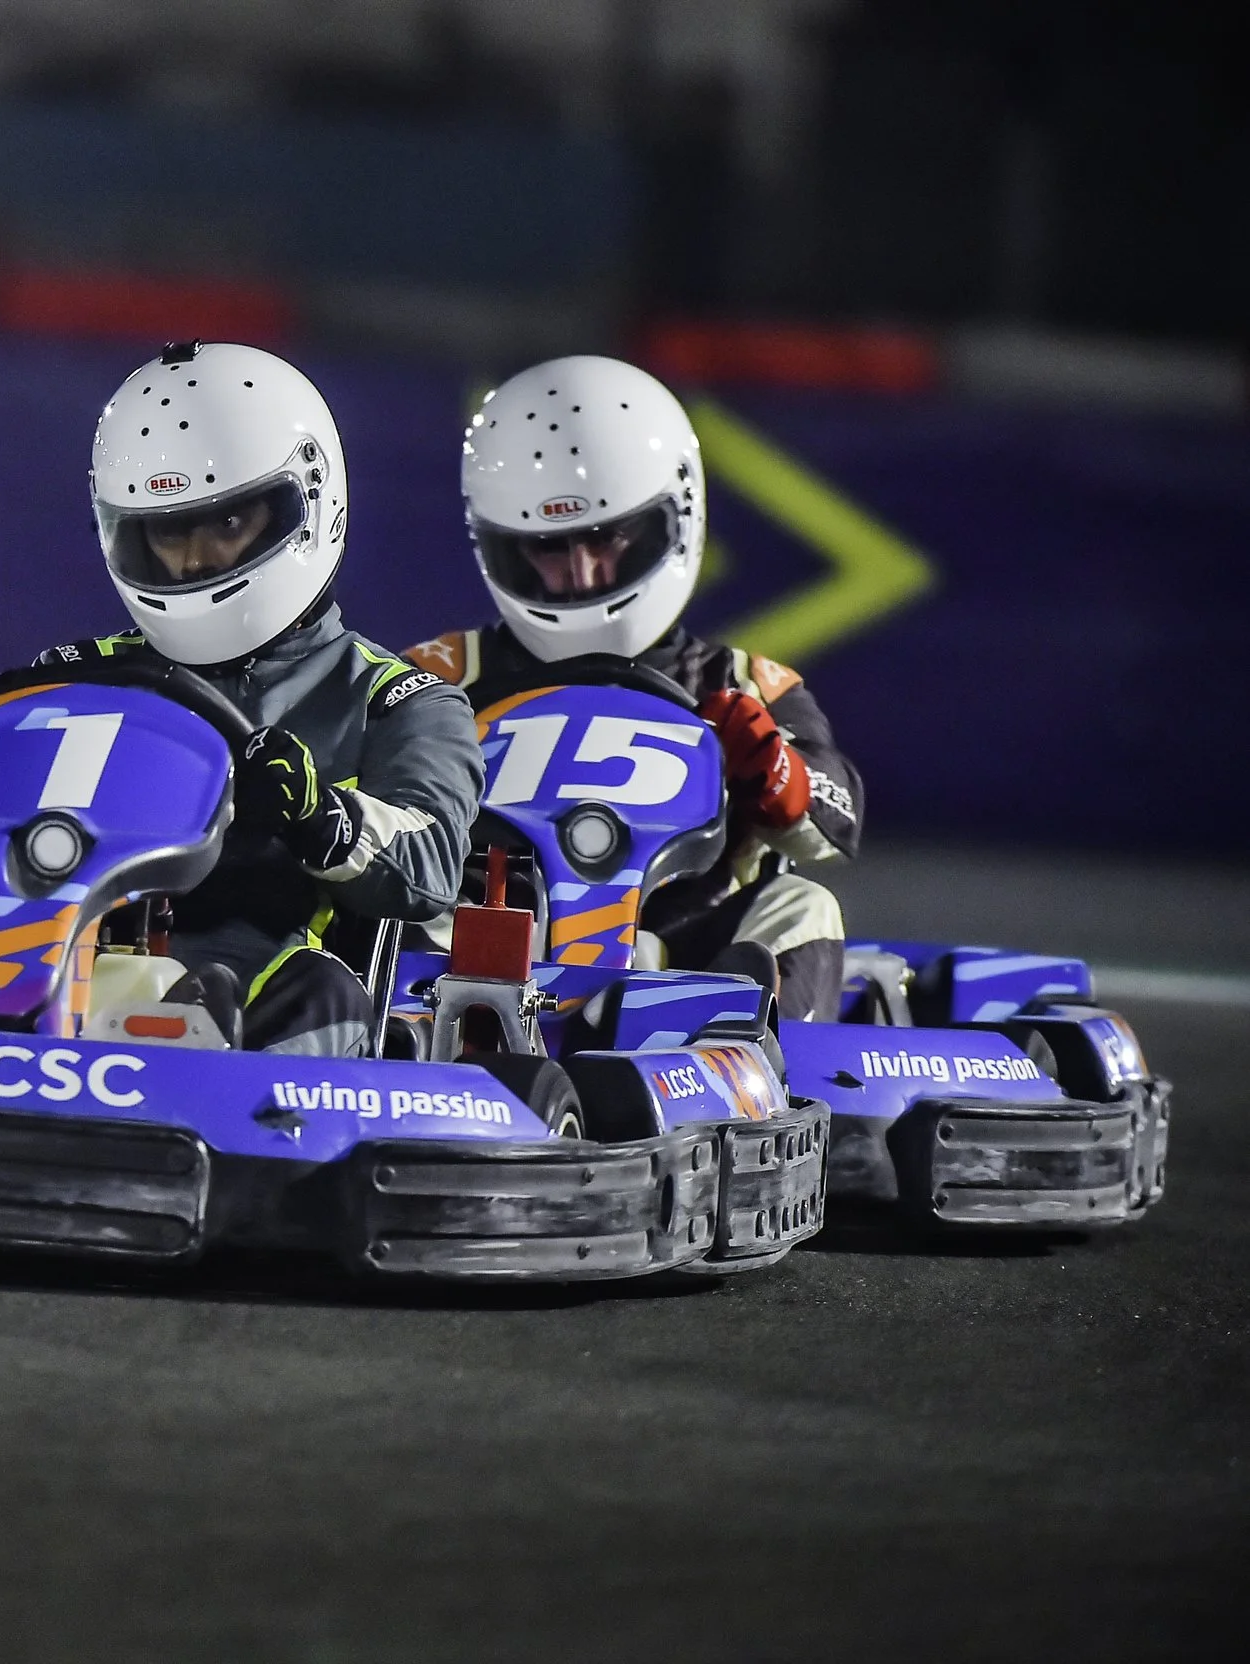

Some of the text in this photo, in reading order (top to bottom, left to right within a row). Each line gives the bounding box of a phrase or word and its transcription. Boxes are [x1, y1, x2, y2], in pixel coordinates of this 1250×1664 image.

[150, 477, 185, 490] BELL
[543, 501, 583, 516] BELL
[37, 713, 124, 809] 1
[484, 714, 704, 806] 15
[660, 1066, 705, 1099] LCSC
[861, 1050, 1041, 1083] living passion
[273, 1081, 512, 1125] living passion
